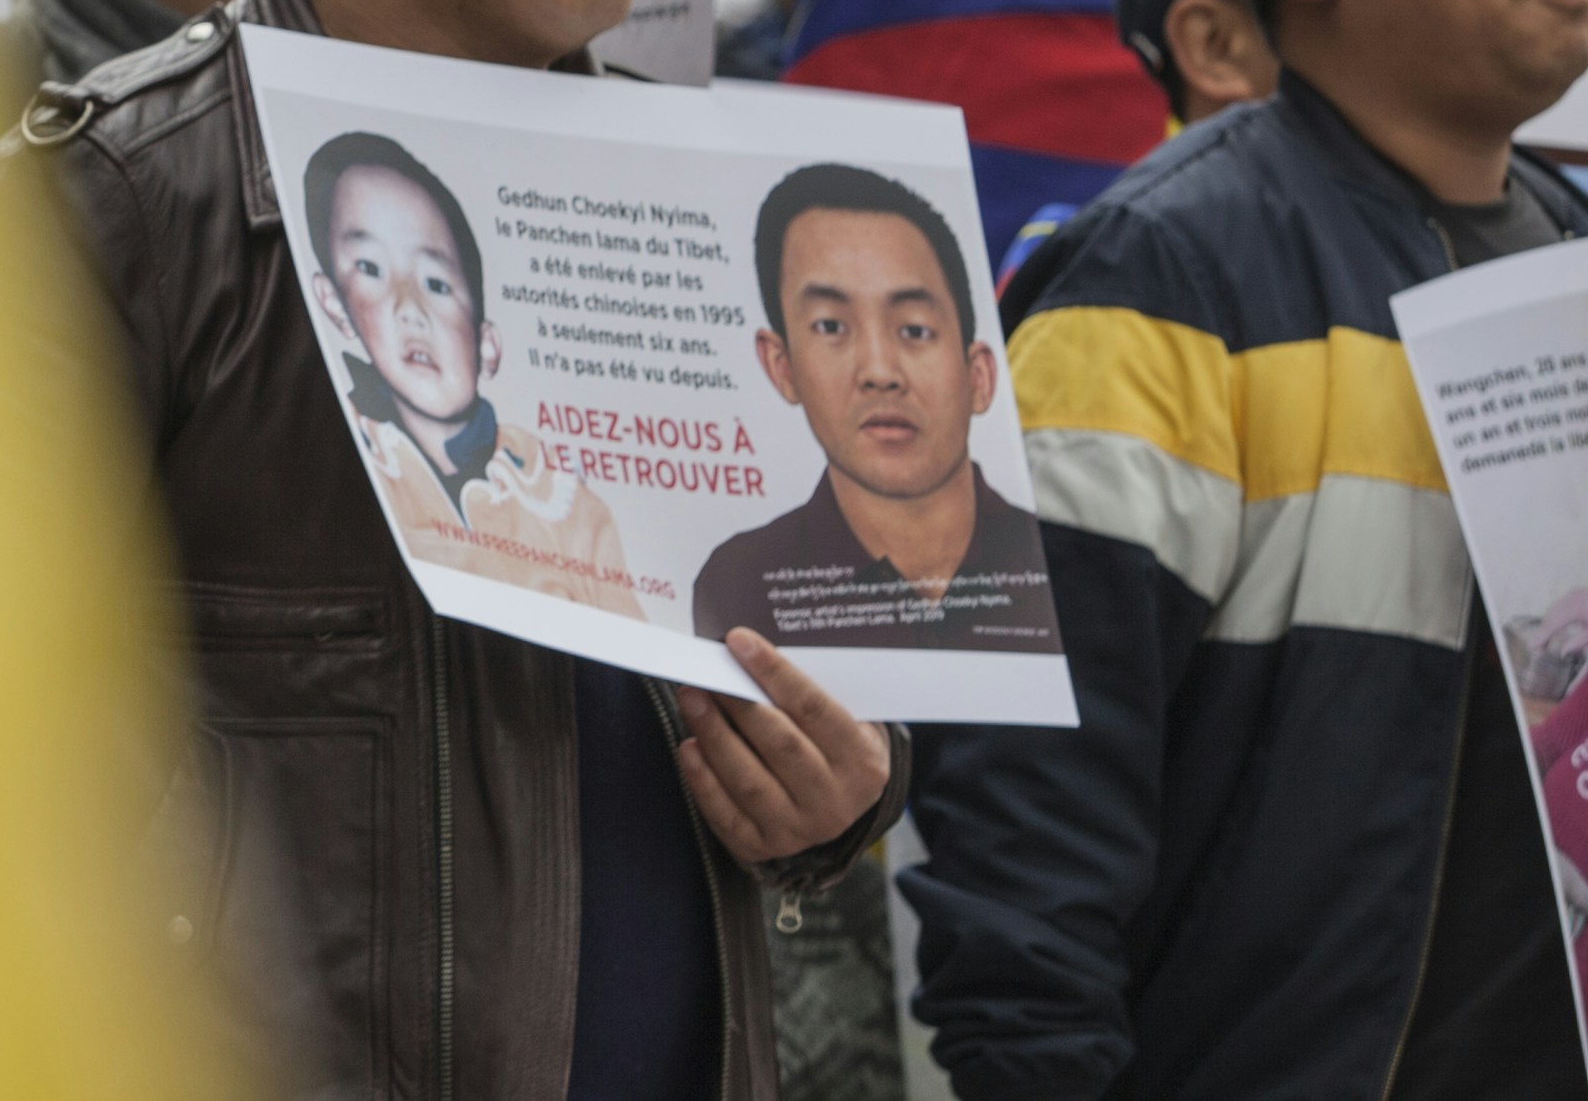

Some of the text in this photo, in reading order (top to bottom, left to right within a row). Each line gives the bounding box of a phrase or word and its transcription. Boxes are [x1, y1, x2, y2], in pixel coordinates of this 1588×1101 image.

[497, 186, 717, 232] Gedhun Choekyi Nyima,
[495, 217, 730, 264] le Panchen lama du Tibet,
[530, 254, 703, 291] a été enlevé par les
[502, 284, 745, 327] autorités chinoises en 1995
[538, 318, 718, 356] à seulement six ans.
[529, 348, 738, 391] Il n'a pas été vu depuis.
[1446, 406, 1476, 424] ans
[1501, 394, 1524, 409] six
[1529, 384, 1569, 402] mois
[538, 401, 755, 455] AIDEZ-NOUS À
[1453, 432, 1475, 449] un
[1481, 426, 1500, 442] an
[1524, 412, 1561, 431] trois
[540, 440, 765, 496] LE RETROUVER
